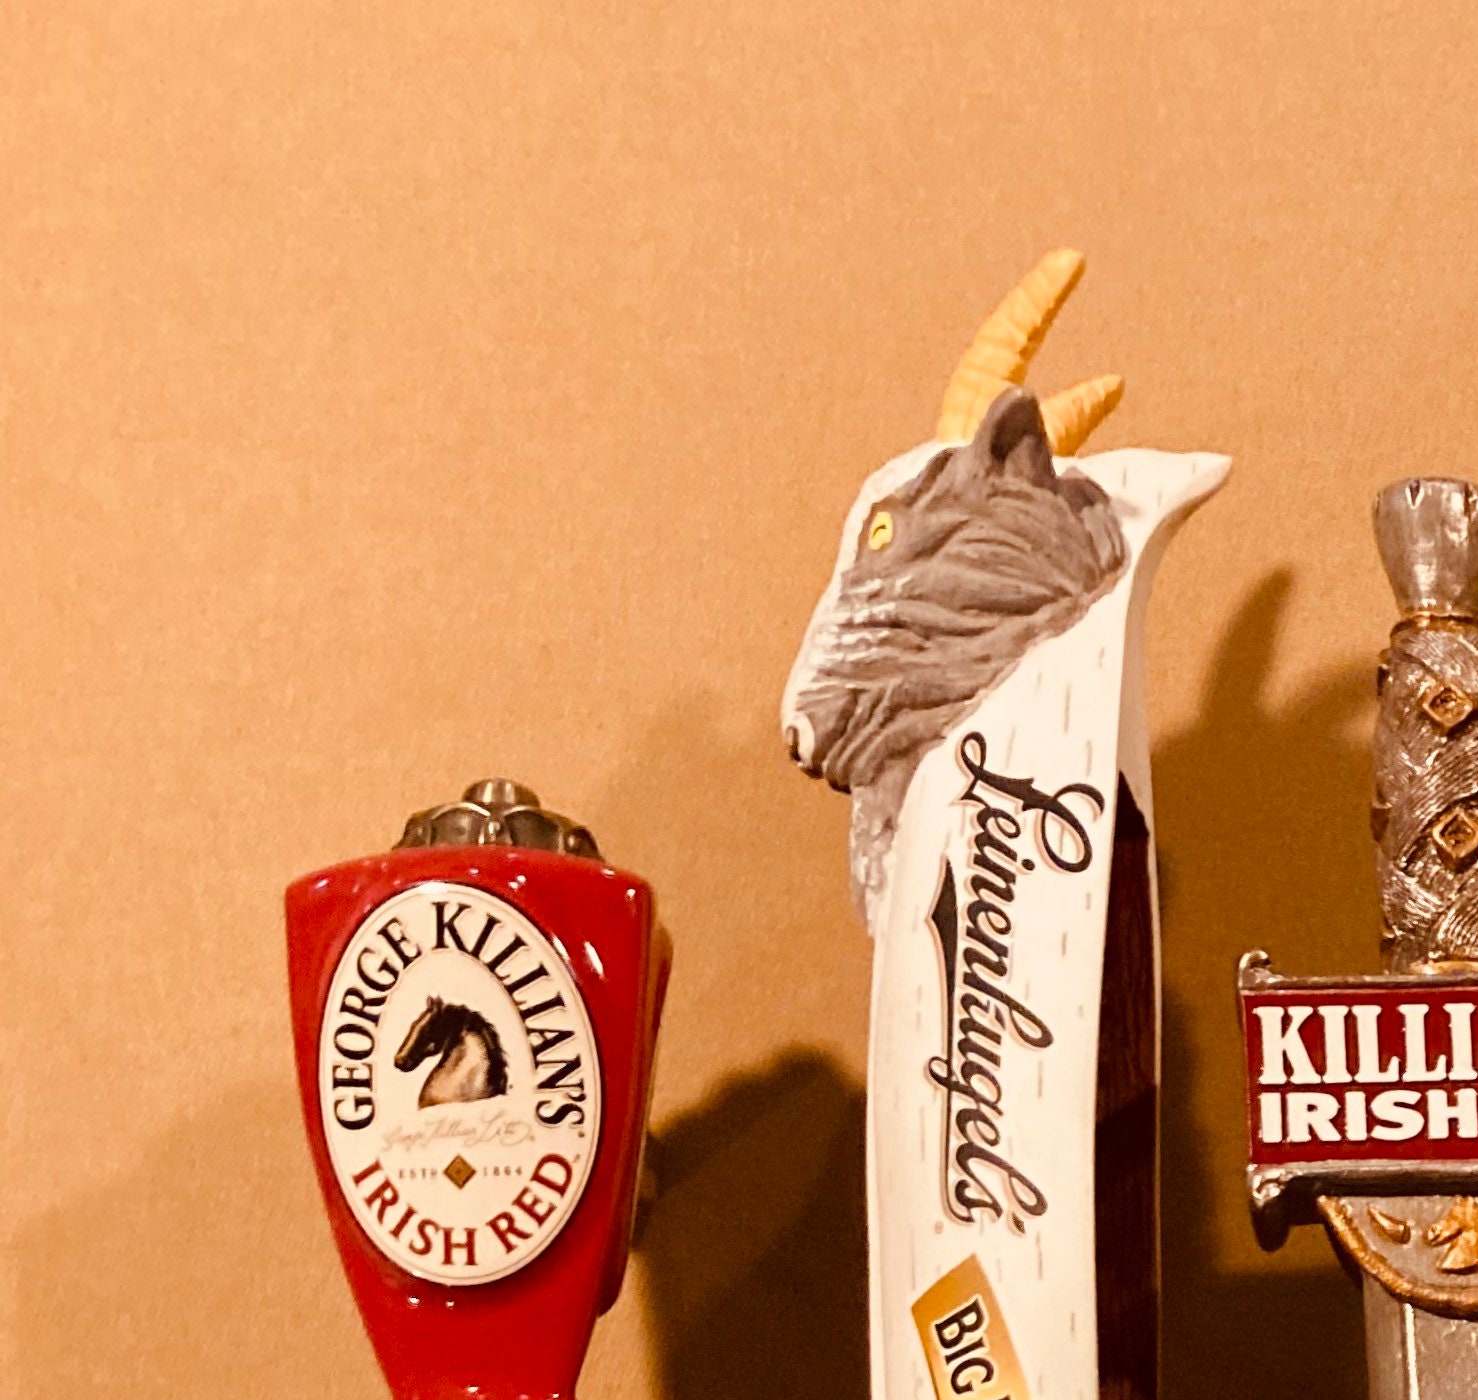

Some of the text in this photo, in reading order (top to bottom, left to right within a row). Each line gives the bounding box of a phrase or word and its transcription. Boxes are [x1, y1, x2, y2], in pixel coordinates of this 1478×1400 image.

[332, 901, 588, 1131] GEORGE KILLIAN'S
[926, 731, 1105, 1236] Leinenkugel's
[352, 1152, 574, 1267] IRISH RED
[483, 1165, 523, 1177] 1864
[934, 1298, 994, 1394] BIG
